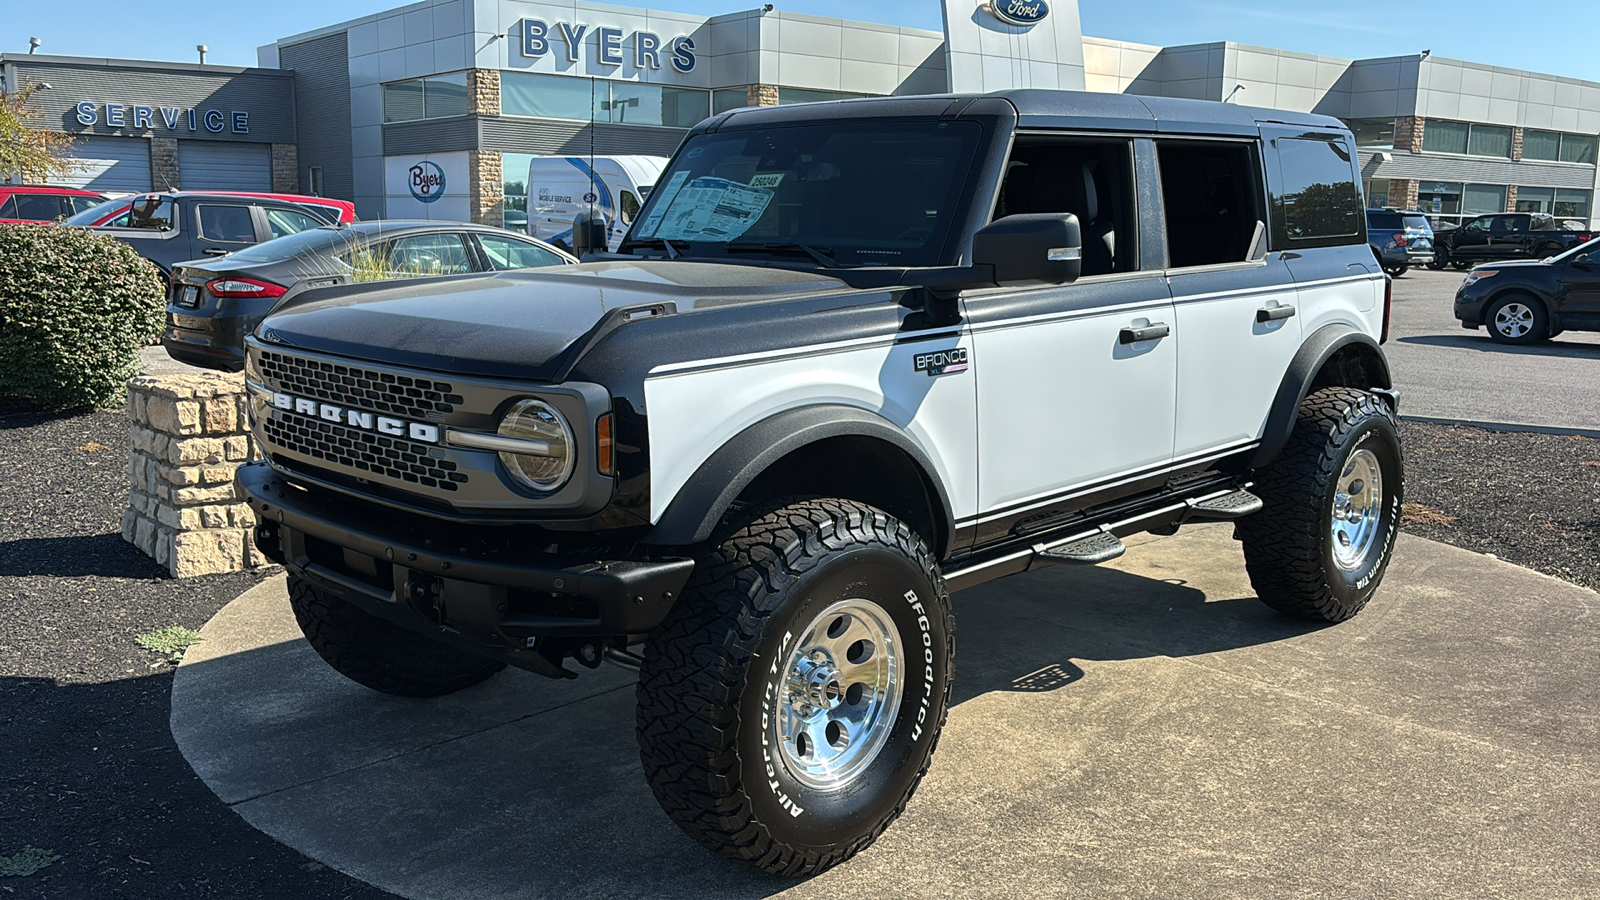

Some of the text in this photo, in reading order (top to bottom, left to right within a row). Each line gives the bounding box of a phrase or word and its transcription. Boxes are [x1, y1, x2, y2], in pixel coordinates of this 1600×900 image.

[1007, 0, 1040, 18] Ford
[522, 17, 697, 73] BYERS
[76, 100, 249, 133] SERVICE
[409, 165, 442, 194] Byers
[539, 194, 572, 203] MOBILE SERVICE
[916, 349, 967, 369] BRONCO
[273, 391, 439, 443] BRONCO
[1368, 494, 1399, 578] All-Terrain
[903, 589, 935, 742] BFGoodrich
[761, 630, 805, 818] All-Terrain T/A
